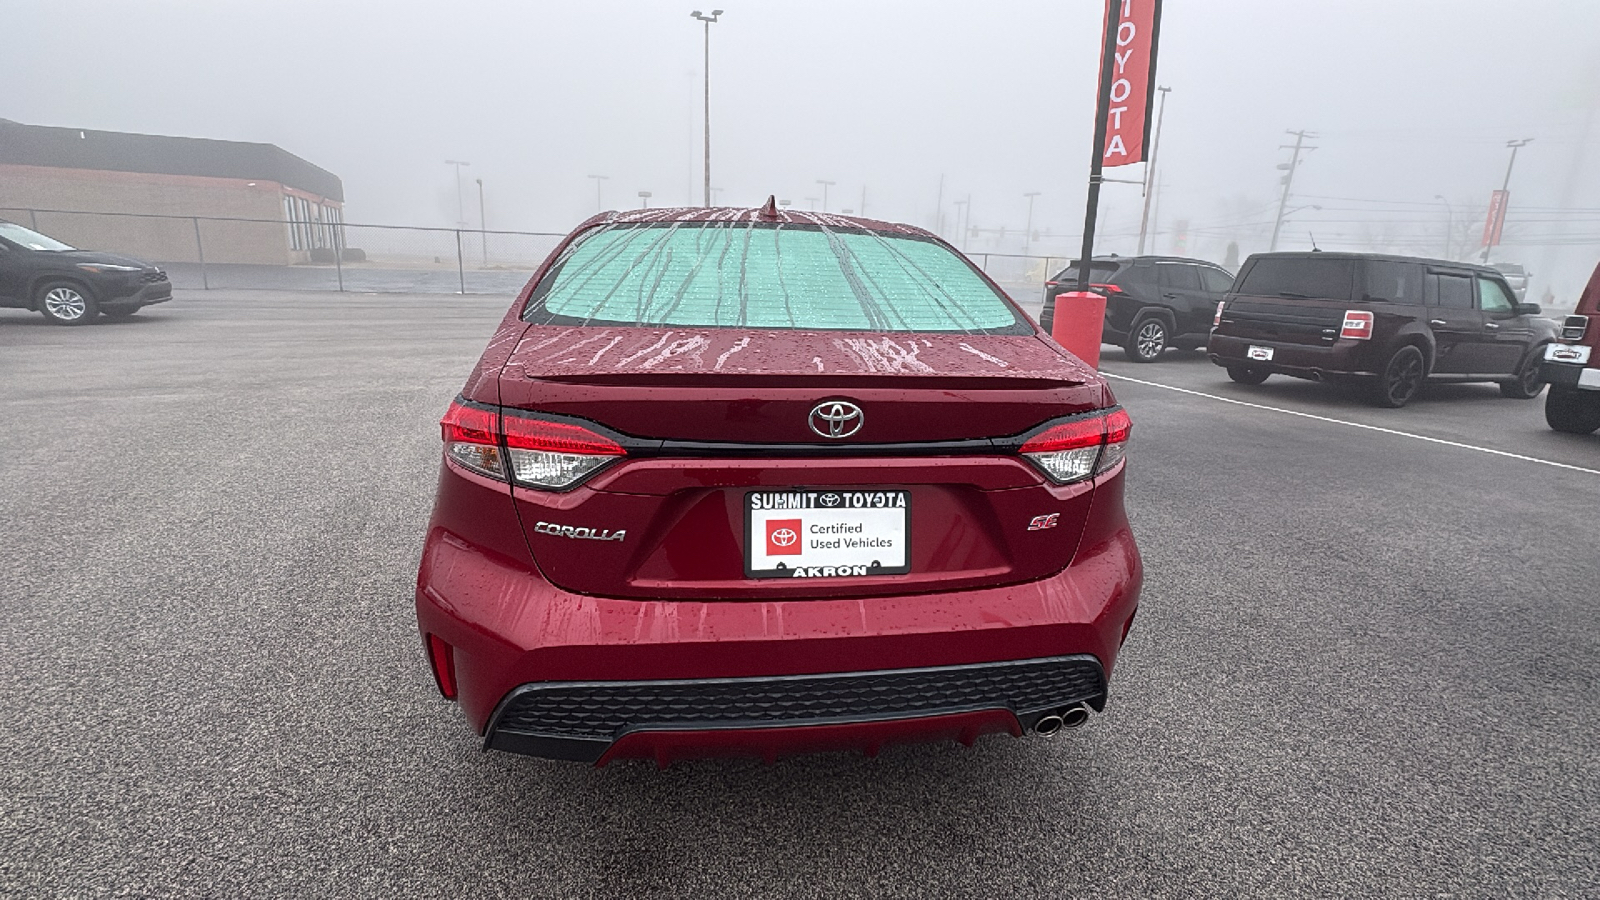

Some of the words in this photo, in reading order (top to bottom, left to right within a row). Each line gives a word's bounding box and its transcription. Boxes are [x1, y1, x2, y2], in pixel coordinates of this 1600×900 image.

[1104, 0, 1136, 158] TOYOTA
[751, 492, 817, 509] SUMMIT
[843, 492, 906, 508] TOYOTA
[810, 523, 863, 534] Certified
[1027, 513, 1060, 530] SE
[534, 521, 627, 542] COROLLA
[810, 538, 841, 549] Used
[843, 537, 892, 548] Vehicles
[793, 565, 867, 577] AKRON
